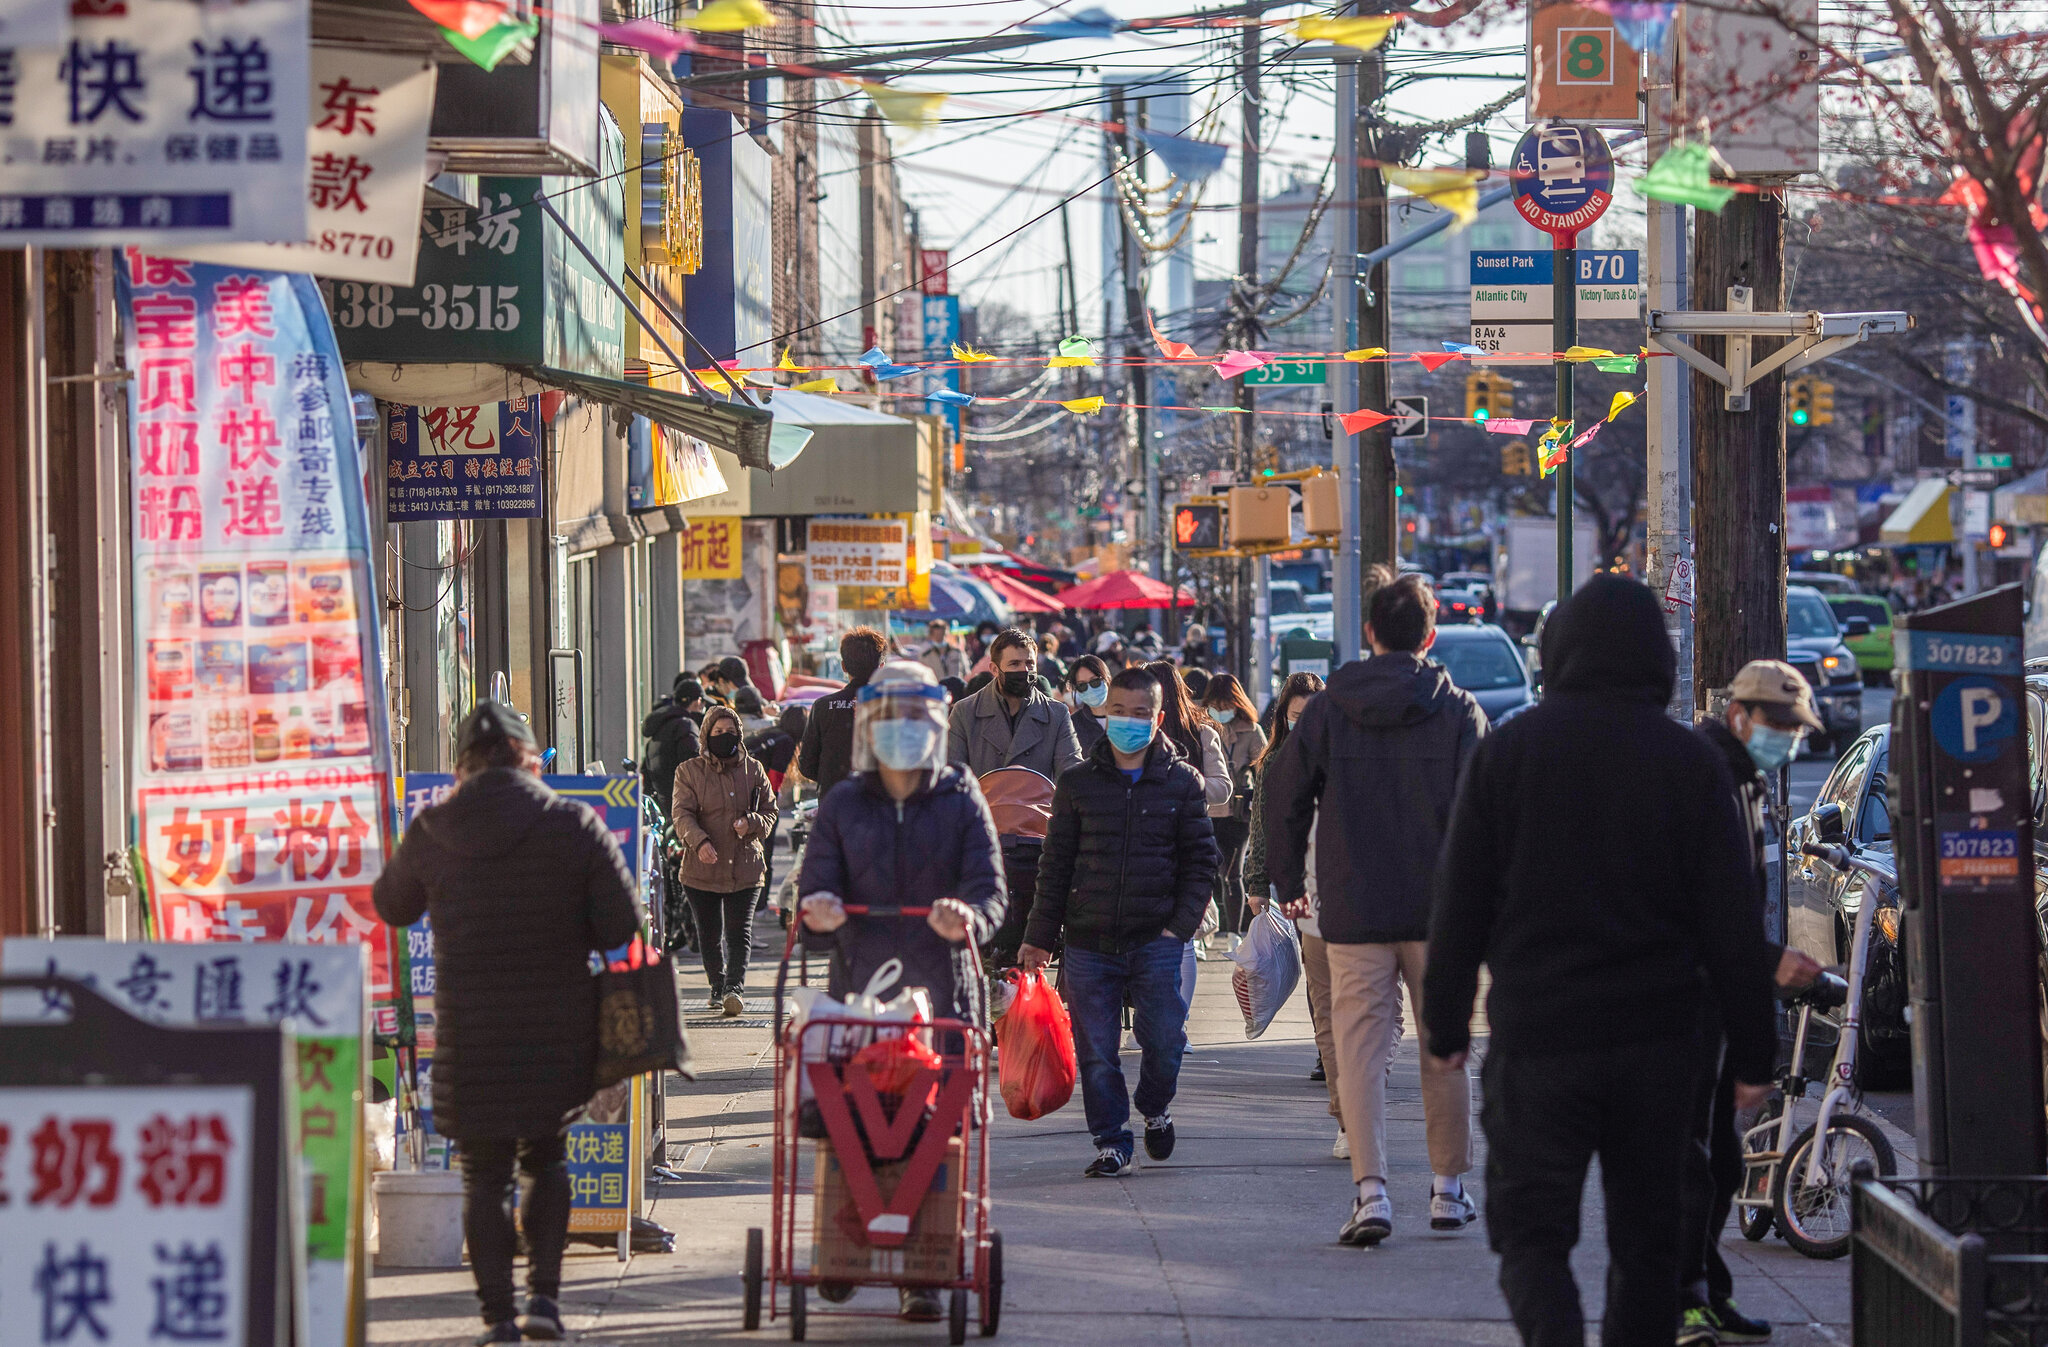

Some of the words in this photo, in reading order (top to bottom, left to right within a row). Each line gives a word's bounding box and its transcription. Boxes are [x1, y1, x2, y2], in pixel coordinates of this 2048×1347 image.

[1566, 35, 1605, 78] 8
[0, 38, 273, 125] 快递
[1521, 198, 1541, 220] NO
[1541, 195, 1604, 228] STANDING
[1477, 255, 1509, 268] Sunset
[1512, 255, 1534, 268] Park
[1580, 255, 1625, 280] B70
[1475, 290, 1508, 303] Atlantic
[1509, 290, 1528, 304] City
[1580, 289, 1602, 302] Victory
[1603, 289, 1619, 302] Tours
[1621, 290, 1626, 301] &
[1627, 290, 1637, 301] Co
[1475, 326, 1482, 339] 8
[1483, 326, 1497, 339] Av
[1498, 326, 1506, 339] &
[1475, 339, 1488, 351] 55
[1489, 339, 1500, 351] St
[1256, 361, 1285, 383] 55
[1295, 361, 1316, 376] ST
[214, 275, 285, 537] 美中快递
[388, 459, 454, 481] 成立公司
[1927, 644, 2003, 666] 307823
[1960, 687, 2002, 753] P
[160, 796, 372, 887] 奶粉
[1943, 838, 2015, 857] 307823
[0, 1110, 233, 1208] 奶粉
[1363, 1203, 1389, 1217] AIR
[1434, 1202, 1457, 1214] AIR
[34, 1241, 229, 1345] 快递
